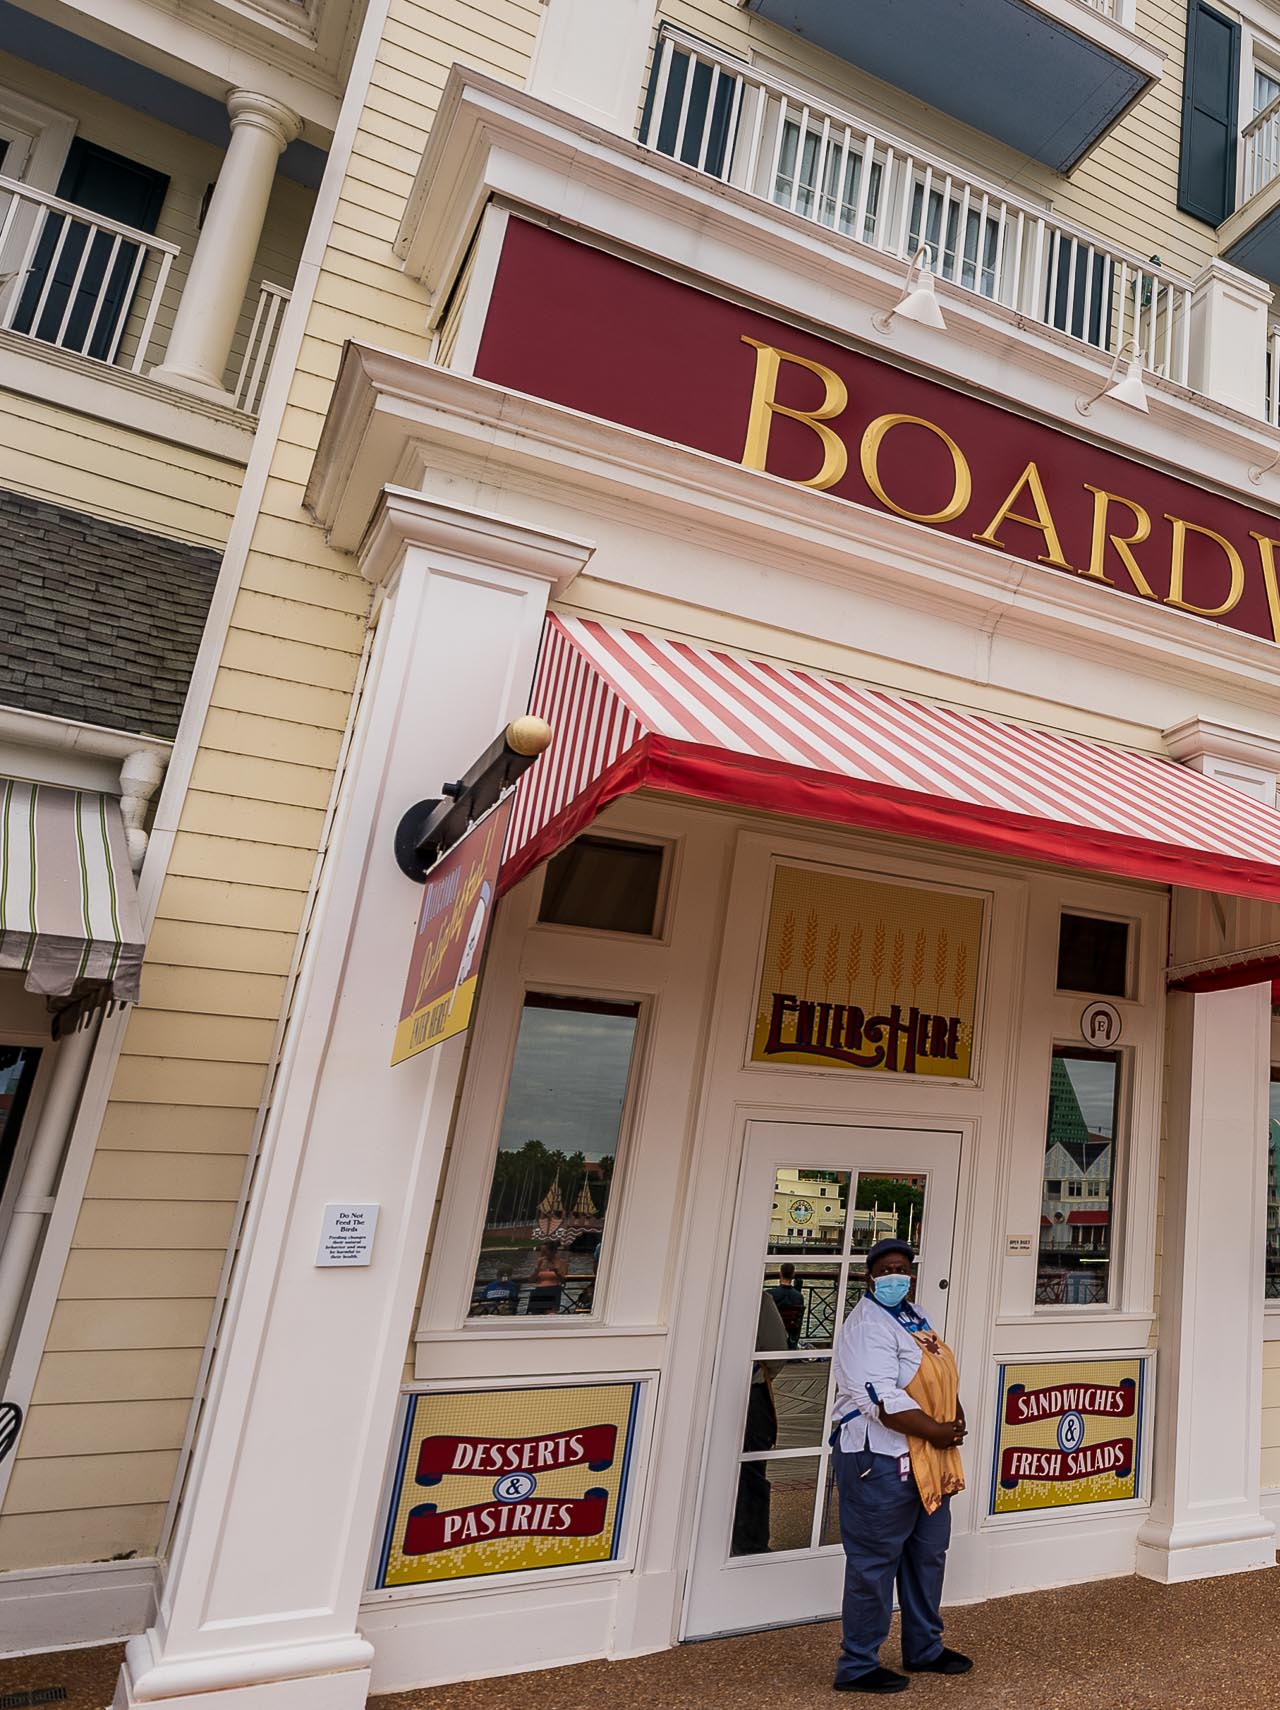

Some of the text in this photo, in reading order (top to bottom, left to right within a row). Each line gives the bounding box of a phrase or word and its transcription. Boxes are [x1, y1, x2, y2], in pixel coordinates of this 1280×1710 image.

[763, 993, 962, 1073] ENTER HERE
[1018, 1388, 1124, 1419] SANDWICHES
[1065, 1419, 1076, 1442] &
[451, 1434, 585, 1470] DESSERTS
[1010, 1444, 1124, 1476] FRESH SALADS
[505, 1478, 523, 1496] &
[443, 1503, 573, 1543] PASTRIES
